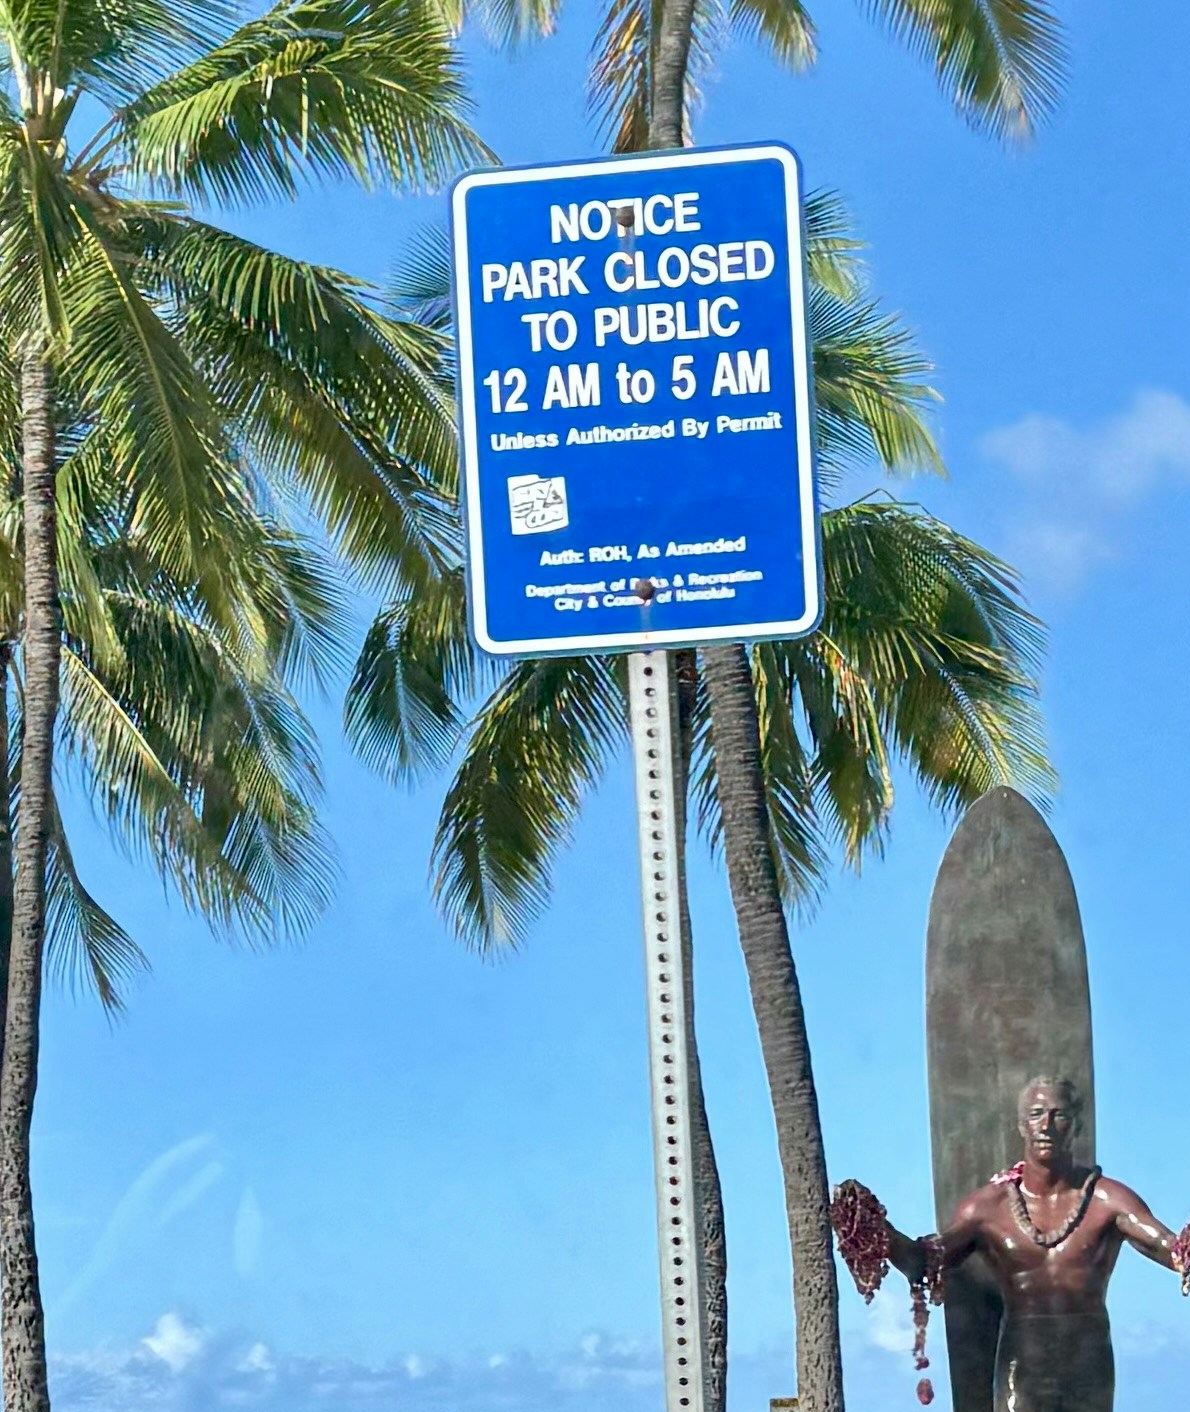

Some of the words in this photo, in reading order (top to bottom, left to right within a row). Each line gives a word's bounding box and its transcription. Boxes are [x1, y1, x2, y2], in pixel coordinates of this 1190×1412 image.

[551, 192, 701, 243] NOTICE
[481, 255, 590, 303] PARK
[603, 240, 775, 293] CLOSED
[521, 310, 578, 352] TO
[594, 297, 741, 347] PUBLIC
[483, 367, 529, 414] 12
[542, 362, 601, 410] AM
[615, 362, 656, 404] to
[671, 355, 697, 400] 5
[711, 348, 771, 397] AM
[490, 432, 559, 452] Unless
[566, 419, 675, 446] Authorized
[681, 418, 709, 438] By
[716, 411, 783, 434] Permit
[588, 545, 633, 563] ROH,
[637, 544, 661, 559] As
[665, 536, 746, 557] Amended
[525, 581, 607, 598] Department
[610, 578, 626, 592] of
[672, 574, 684, 587] &
[688, 570, 763, 586] Recreation
[554, 597, 583, 612] City
[587, 595, 599, 609] &
[656, 591, 672, 604] of
[676, 586, 736, 602] Honolulu
